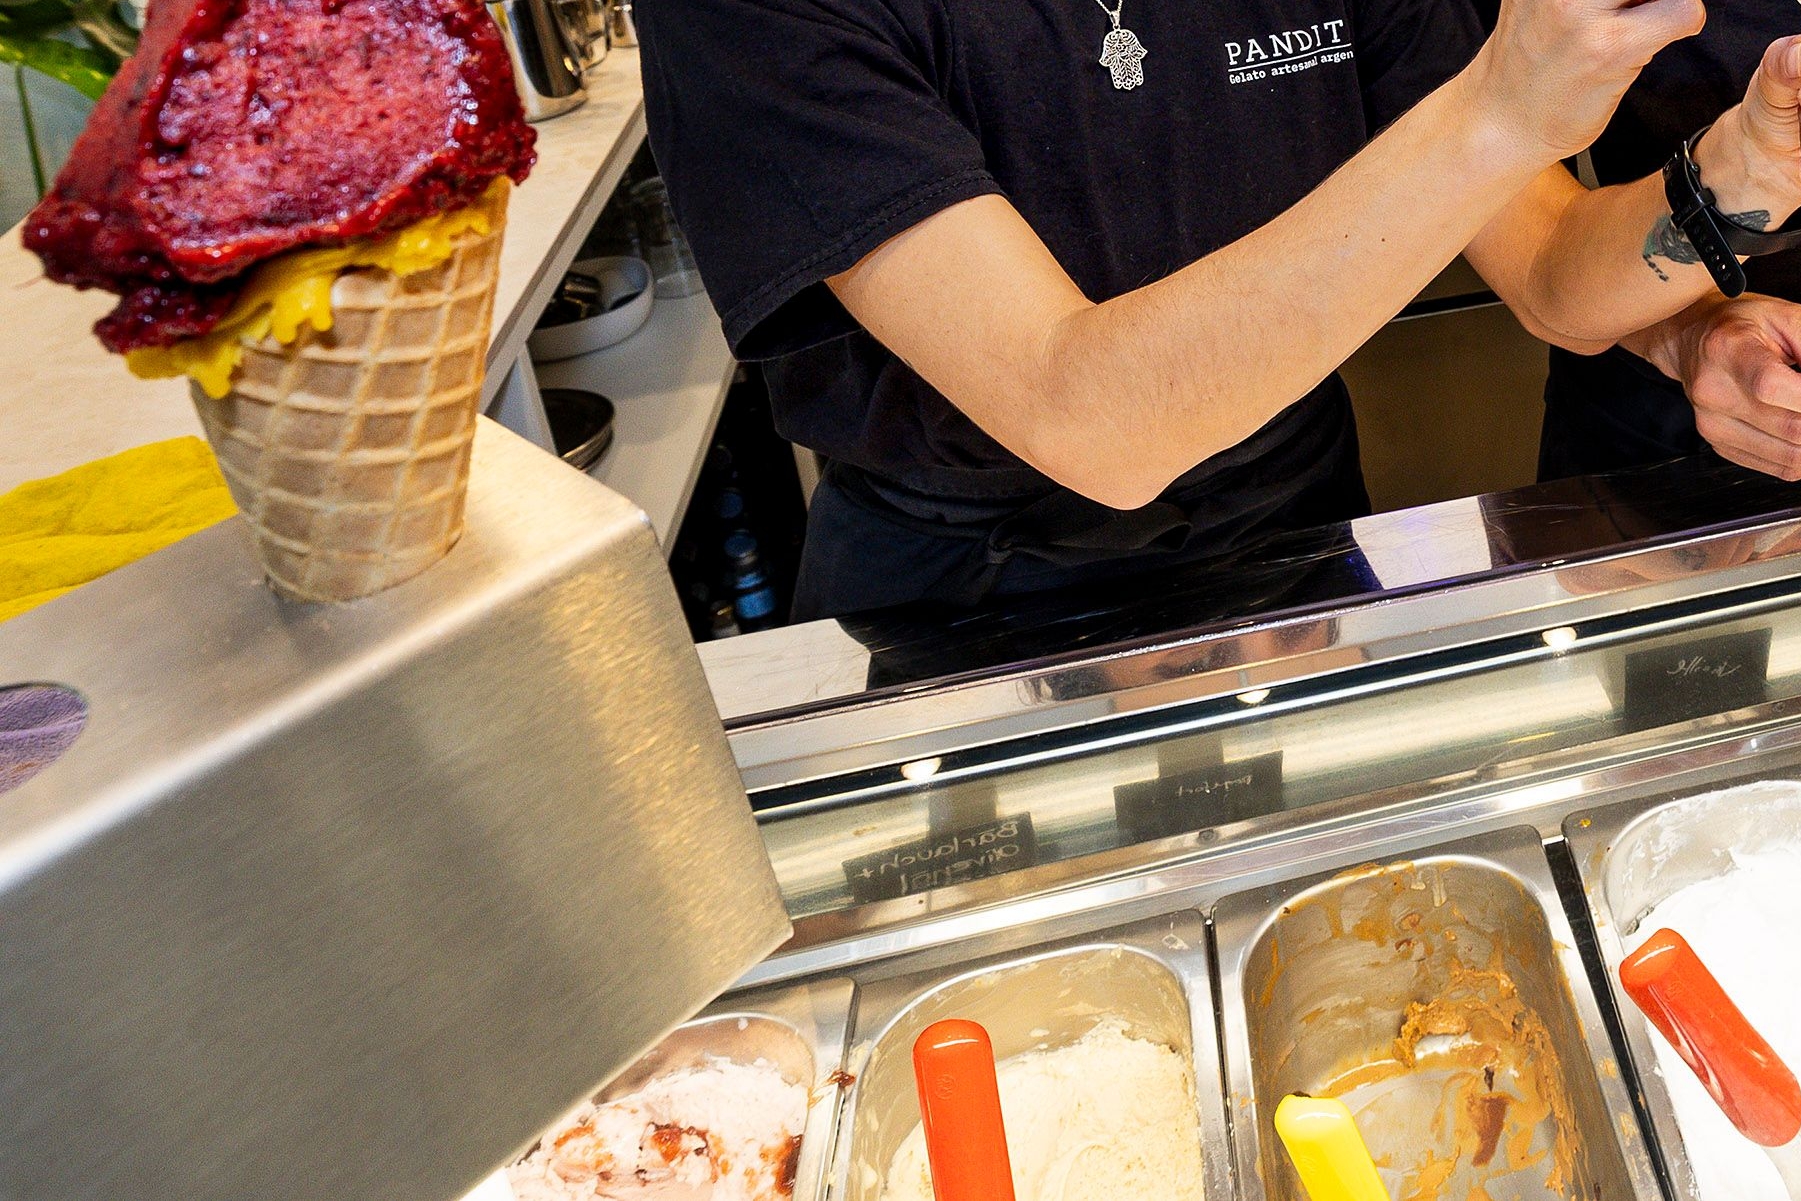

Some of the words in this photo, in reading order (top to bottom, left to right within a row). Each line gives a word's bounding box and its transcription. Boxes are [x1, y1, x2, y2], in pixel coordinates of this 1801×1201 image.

[1225, 19, 1344, 66] PANDIT
[1228, 70, 1267, 85] Gelato
[1320, 50, 1354, 65] argen
